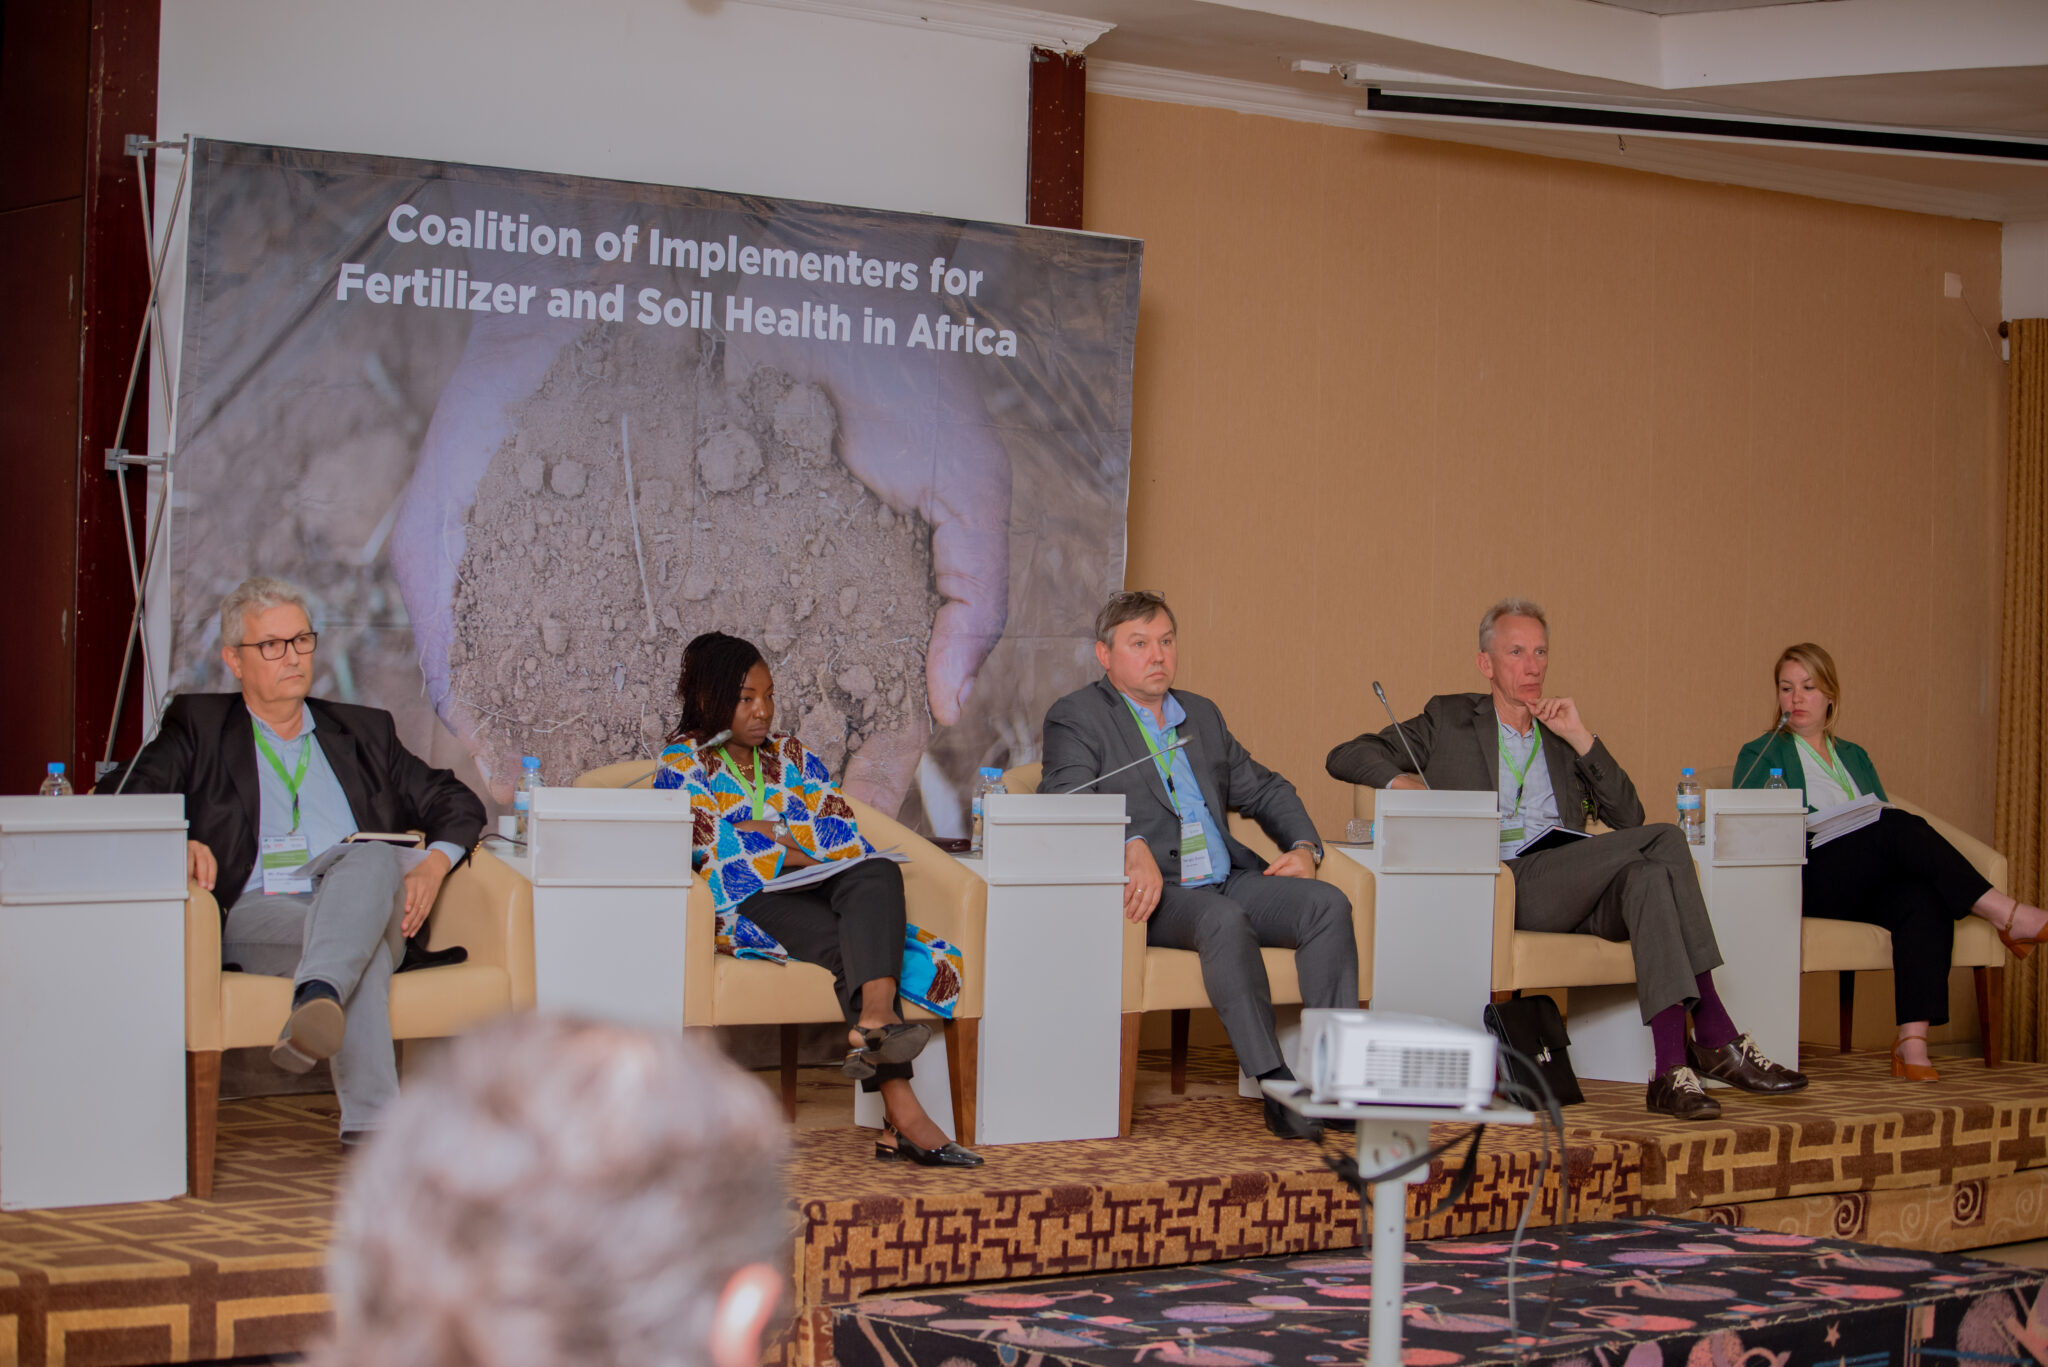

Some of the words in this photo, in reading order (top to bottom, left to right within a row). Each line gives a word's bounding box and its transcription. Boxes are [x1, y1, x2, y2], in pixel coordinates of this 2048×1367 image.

[387, 204, 582, 258] Coalition
[594, 224, 638, 262] of
[649, 228, 919, 291] Implementers
[929, 257, 984, 297] for
[336, 263, 537, 315] Fertilizer
[547, 284, 625, 323] and
[636, 287, 713, 330] Soil
[725, 295, 851, 342] Health
[862, 307, 896, 346] in
[906, 313, 1017, 357] Africa
